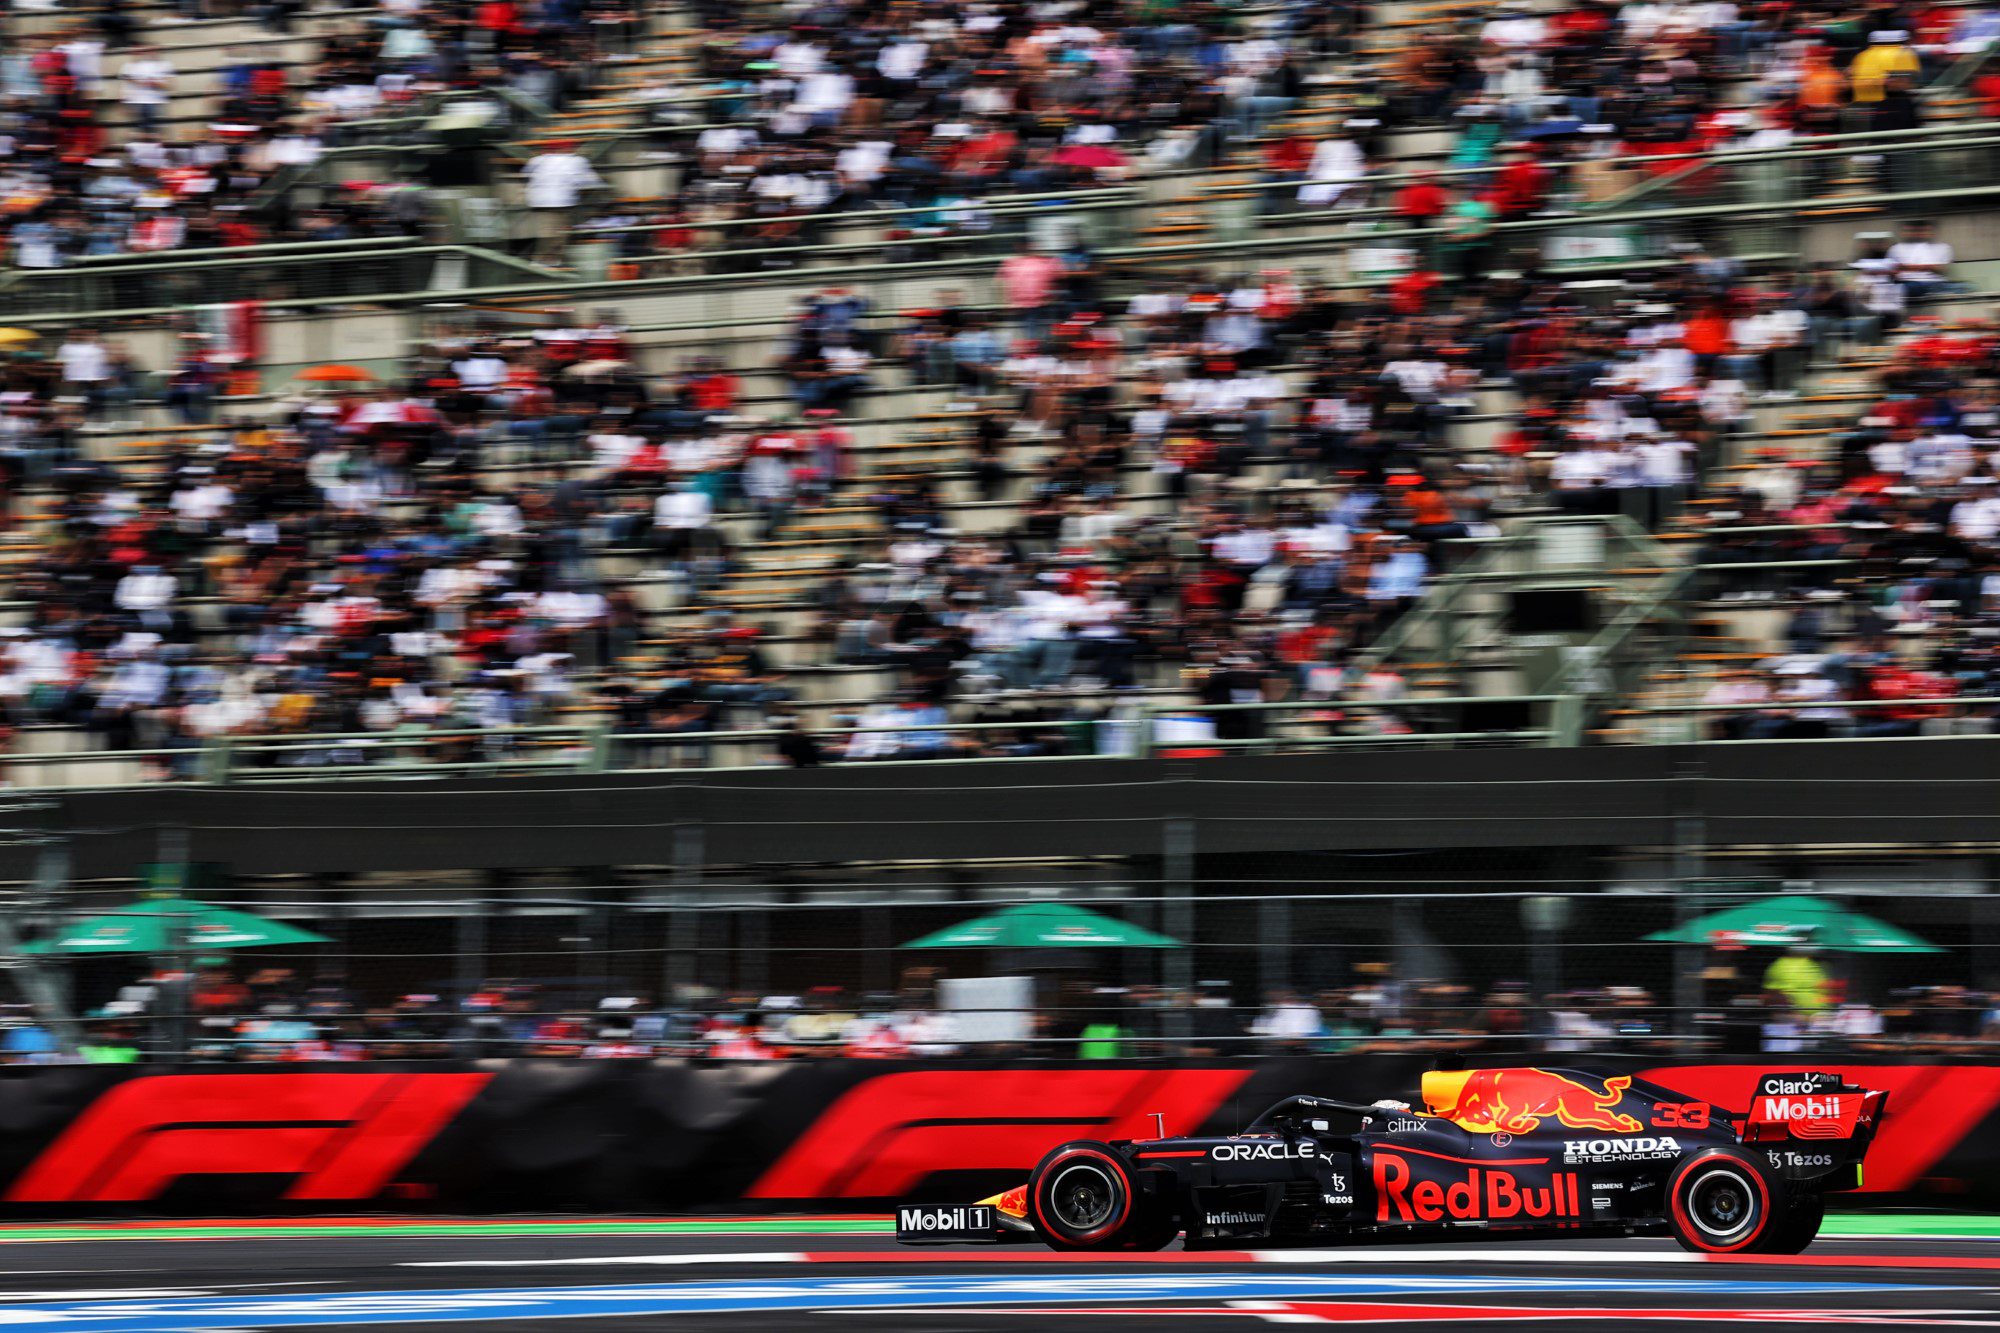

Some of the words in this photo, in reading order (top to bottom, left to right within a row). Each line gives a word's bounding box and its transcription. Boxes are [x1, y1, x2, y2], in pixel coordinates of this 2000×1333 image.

[1765, 1076, 1816, 1095] Claro
[1651, 1102, 1711, 1129] 33
[1765, 1097, 1840, 1120] Mobil
[1387, 1118, 1427, 1132] citrix
[1211, 1142, 1315, 1161] ORACLE
[1564, 1136, 1681, 1155] HONDA
[1785, 1151, 1832, 1166] Tezos
[1323, 1194, 1354, 1204] Tezos
[901, 1208, 965, 1231] Mobil
[1206, 1211, 1266, 1225] infinitum
